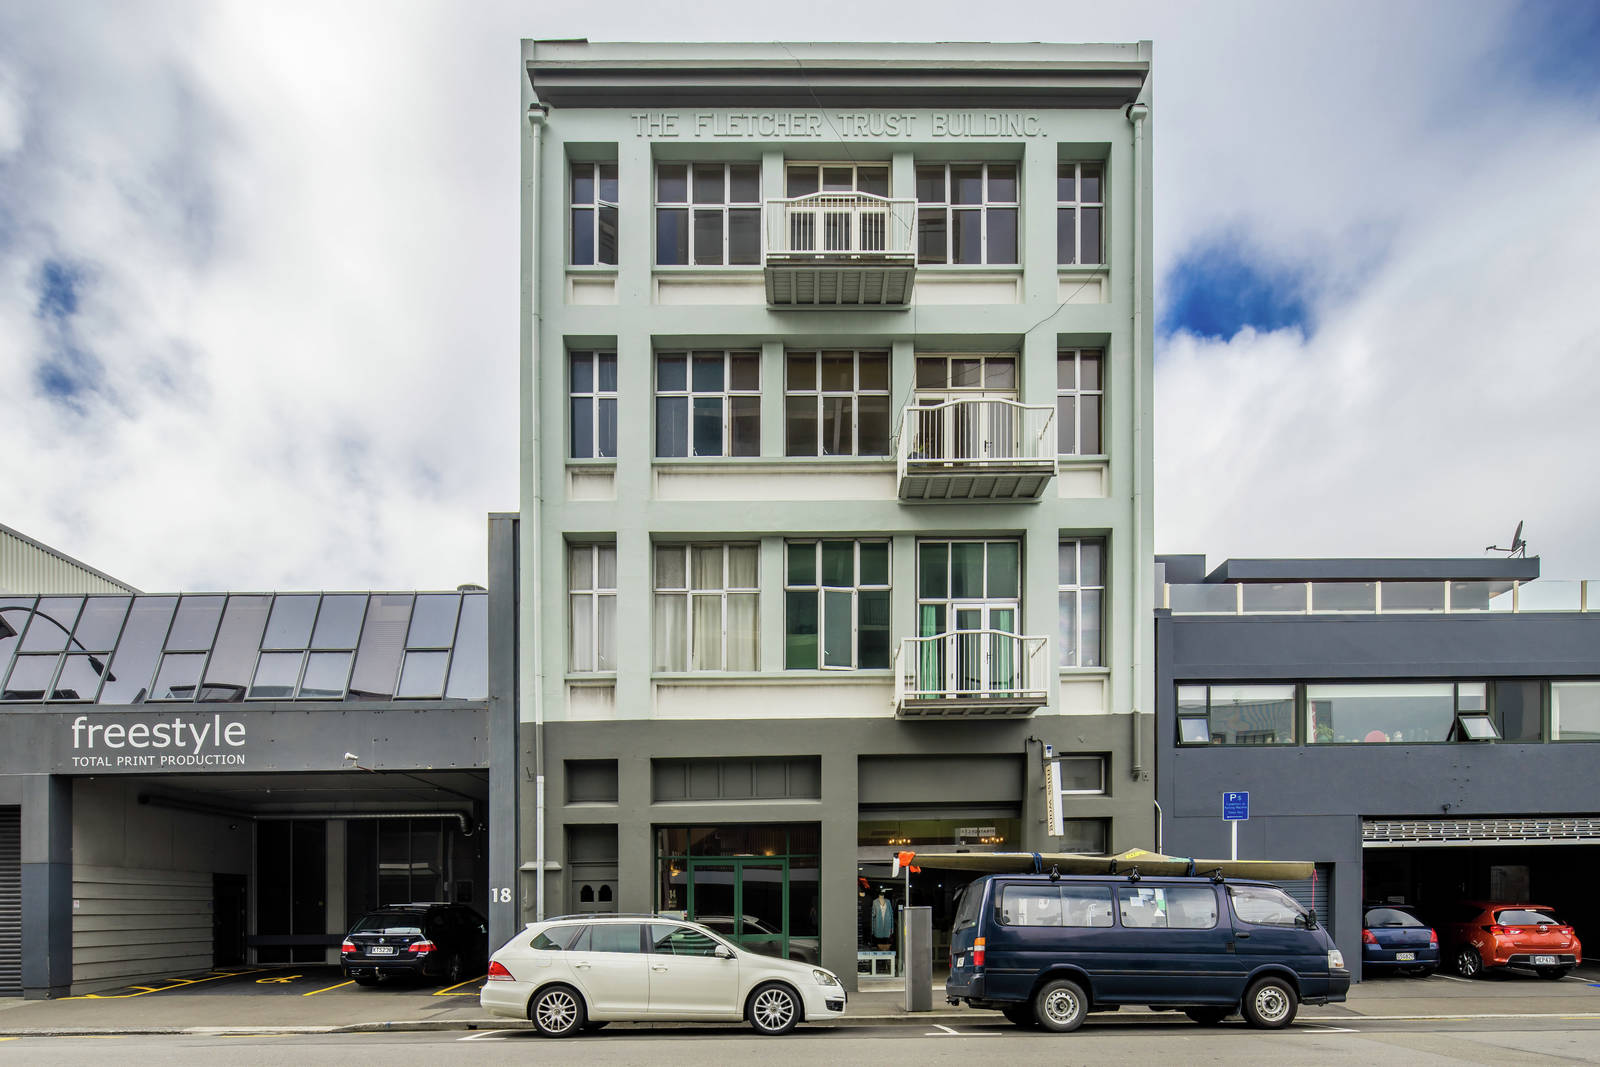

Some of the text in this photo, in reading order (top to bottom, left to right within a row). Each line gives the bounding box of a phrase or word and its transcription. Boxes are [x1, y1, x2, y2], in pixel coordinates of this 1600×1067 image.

[631, 112, 680, 138] THE
[694, 112, 823, 138] FLETCHER
[838, 112, 917, 138] TRUST
[72, 714, 246, 755] freestyle
[72, 754, 245, 767] TOTAL PRINT PRODUCTION
[1229, 793, 1237, 802] P
[491, 887, 512, 903] 18
